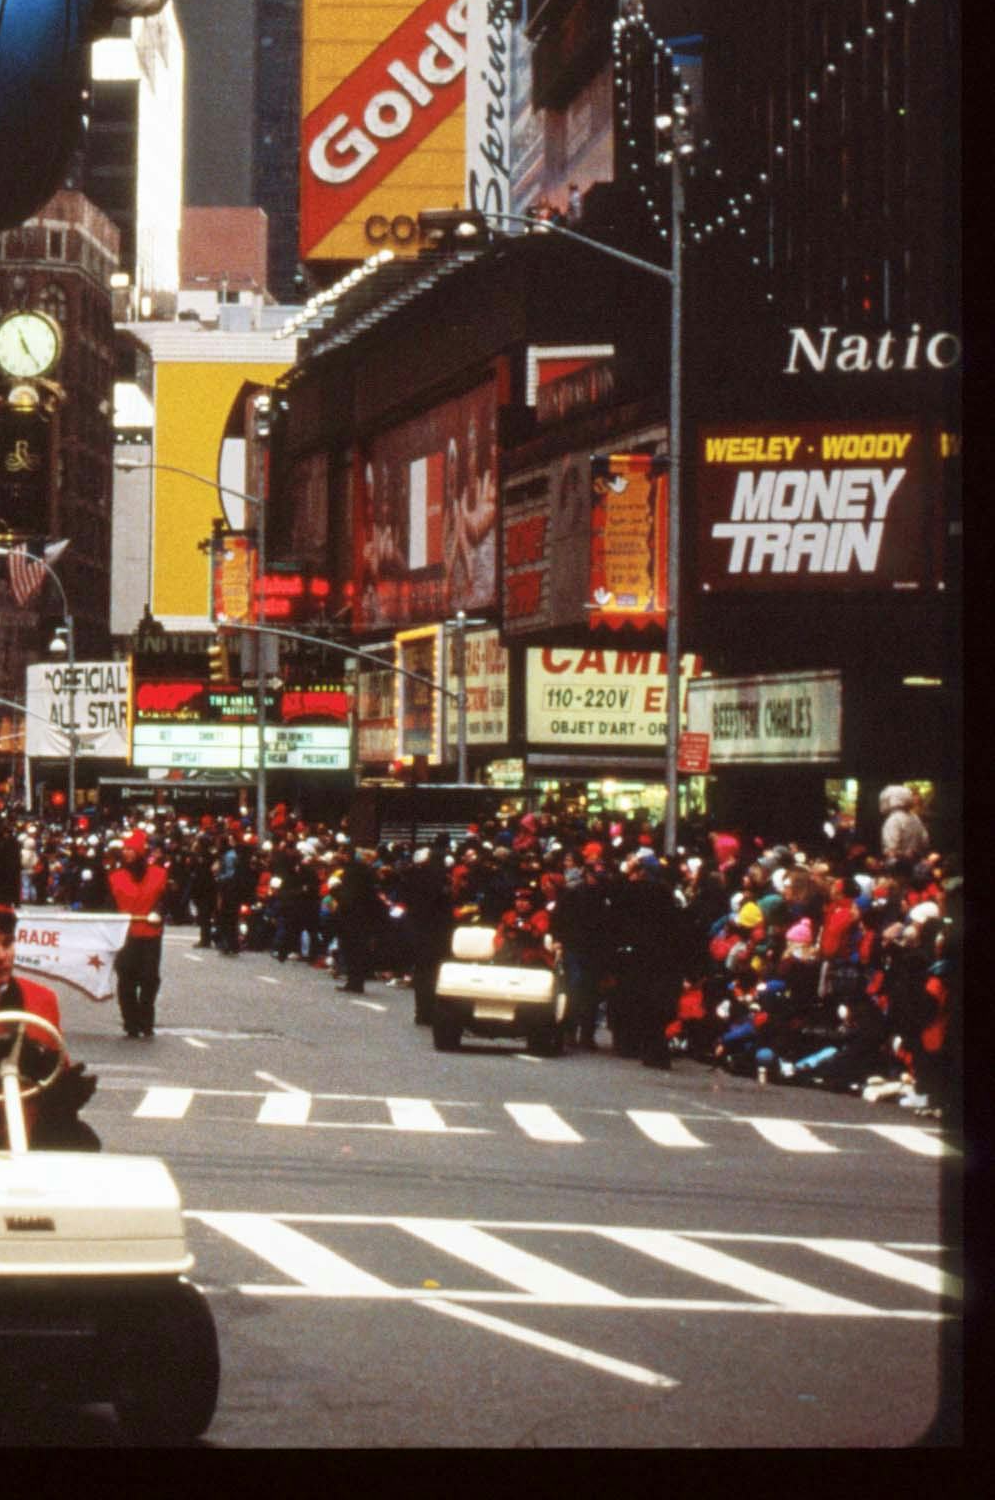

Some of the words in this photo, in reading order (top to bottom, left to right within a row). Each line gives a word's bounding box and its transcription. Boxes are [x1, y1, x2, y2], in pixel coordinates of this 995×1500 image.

[364, 214, 422, 246] CO
[706, 436, 801, 463] WESLEY
[822, 433, 911, 461] WOODY
[730, 468, 906, 521] MONEY
[711, 521, 884, 573] TRAIN
[50, 704, 81, 729] ALL
[550, 720, 592, 735] OBJET
[18, 927, 60, 949] RADE
